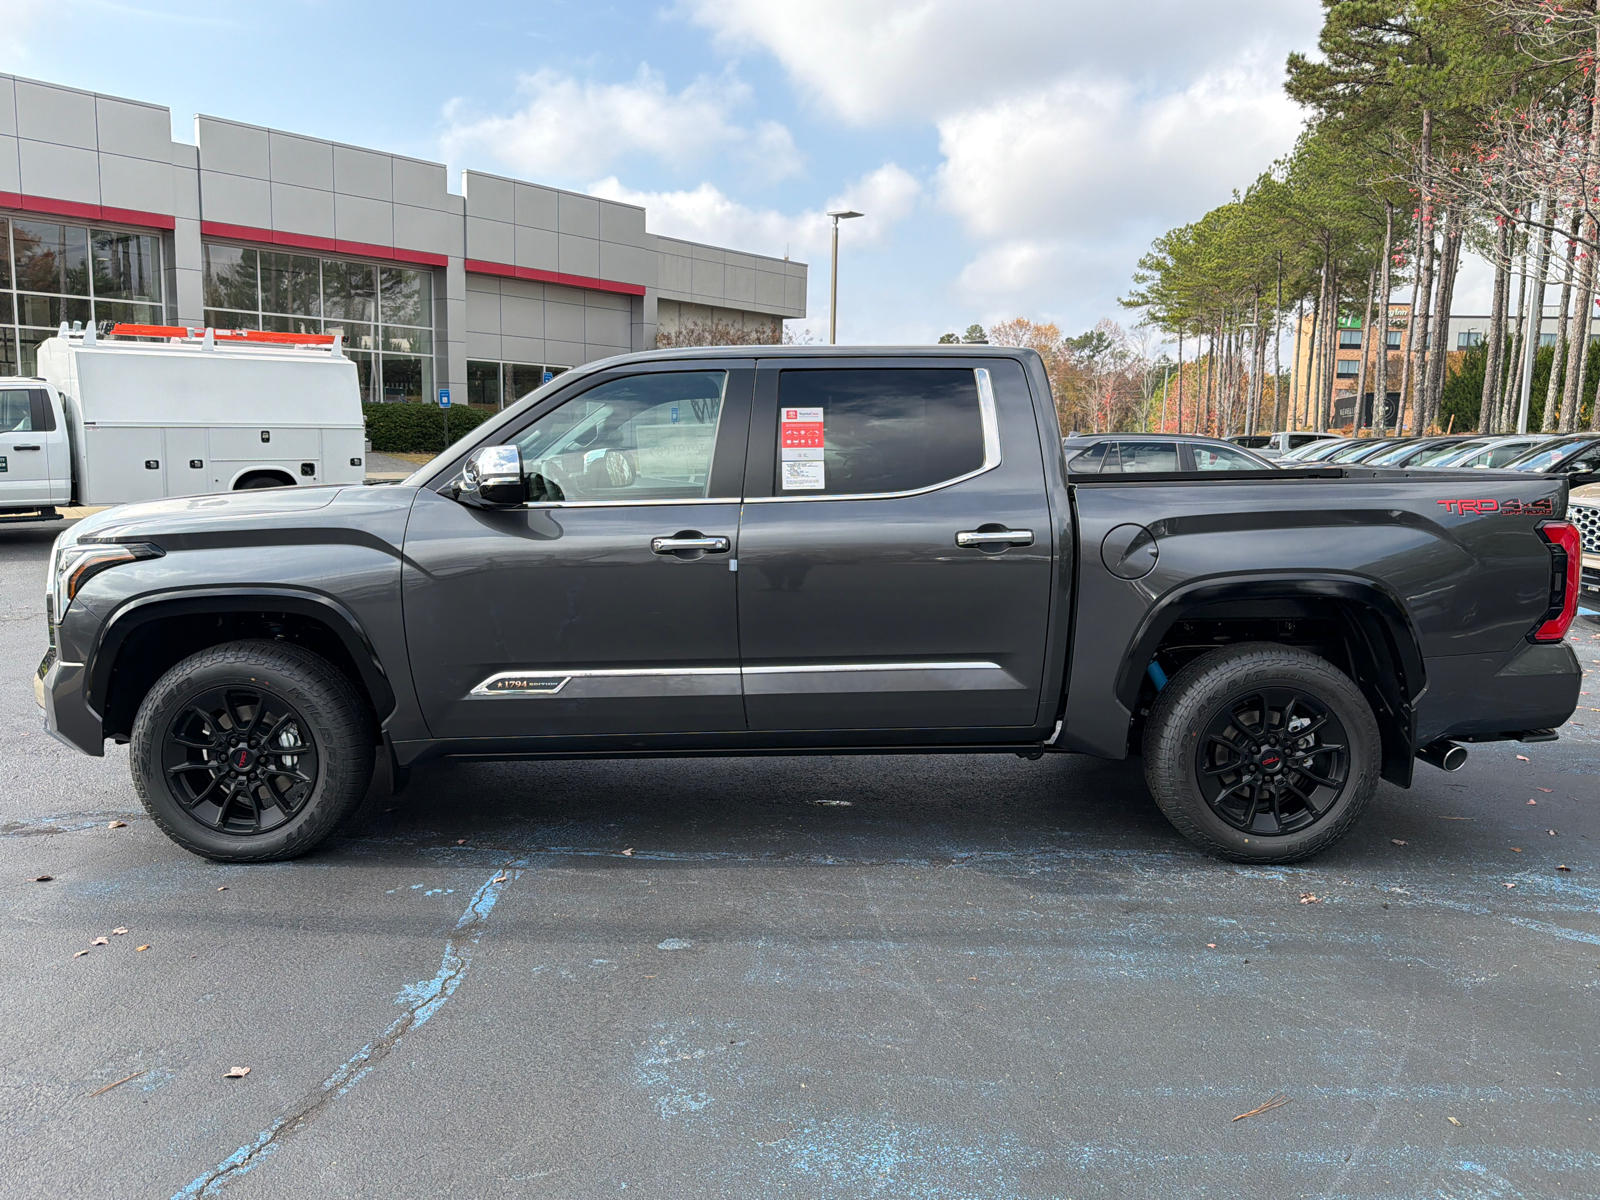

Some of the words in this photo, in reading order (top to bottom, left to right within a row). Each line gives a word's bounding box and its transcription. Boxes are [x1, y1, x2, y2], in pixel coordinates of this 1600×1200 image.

[1437, 499, 1499, 515] TRD
[1500, 498, 1553, 511] 4x4
[504, 680, 527, 688] 1794
